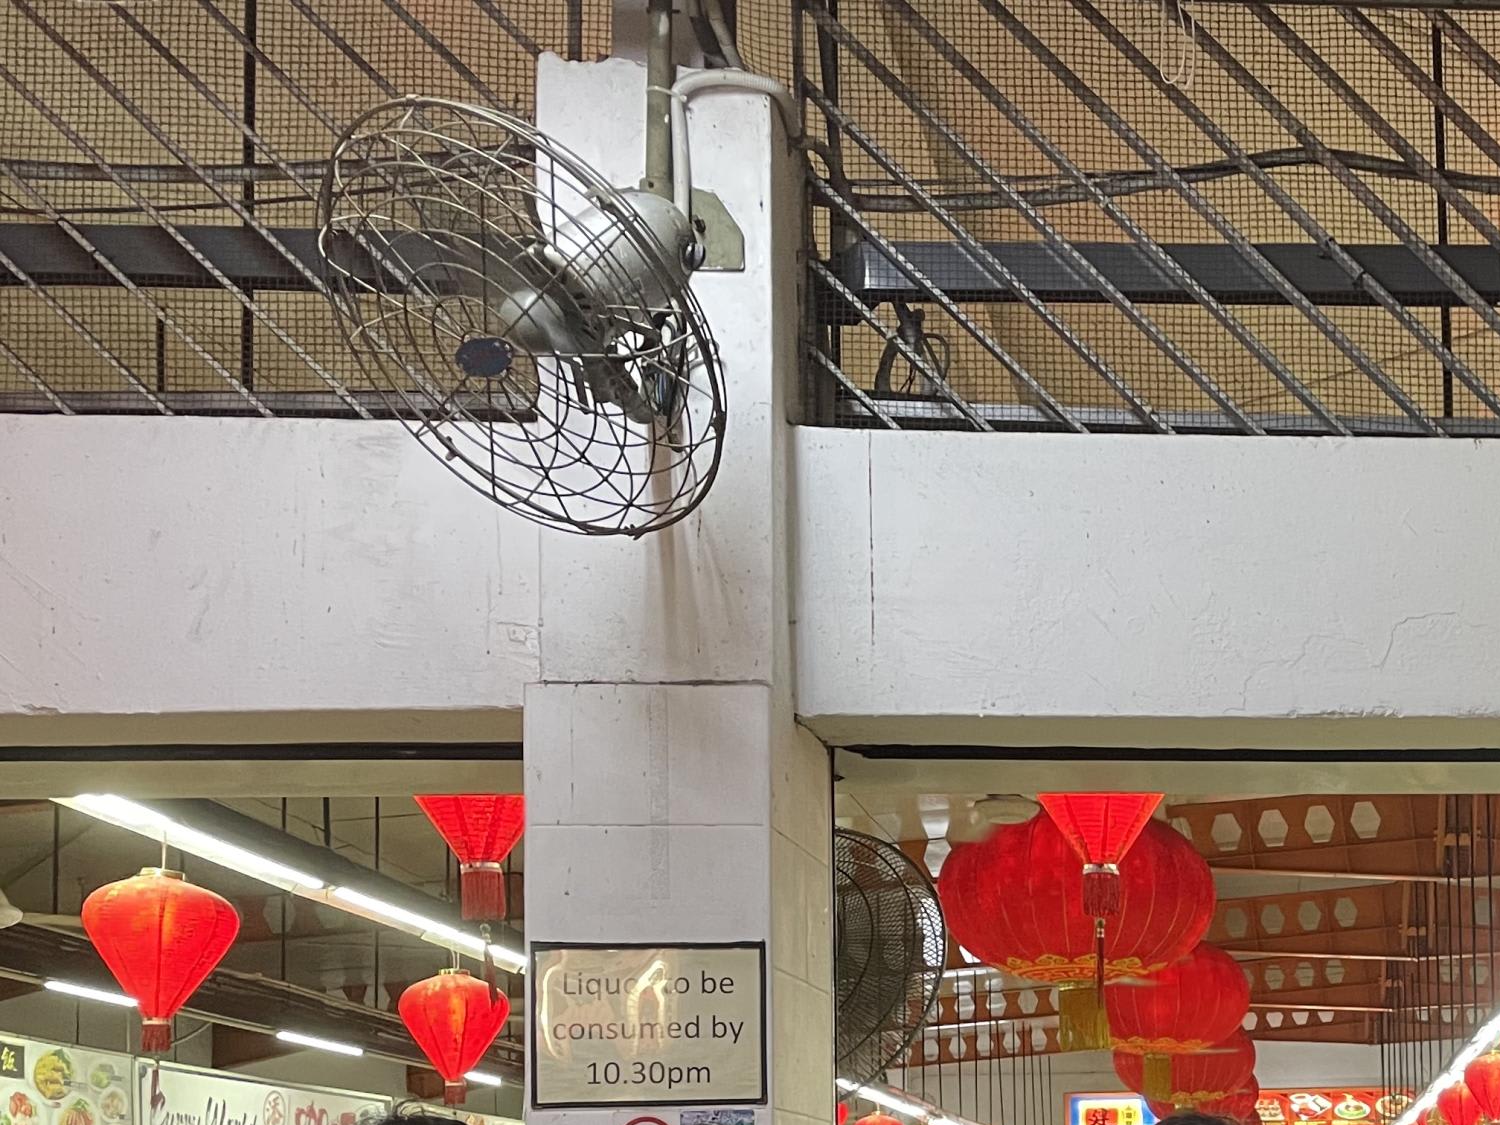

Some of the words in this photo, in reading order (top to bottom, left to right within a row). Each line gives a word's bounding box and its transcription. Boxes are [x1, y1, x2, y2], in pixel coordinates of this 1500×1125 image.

[701, 970, 735, 994] be
[553, 1015, 701, 1040] consumed
[712, 1015, 744, 1044] by
[587, 1061, 711, 1089] 10.30pm
